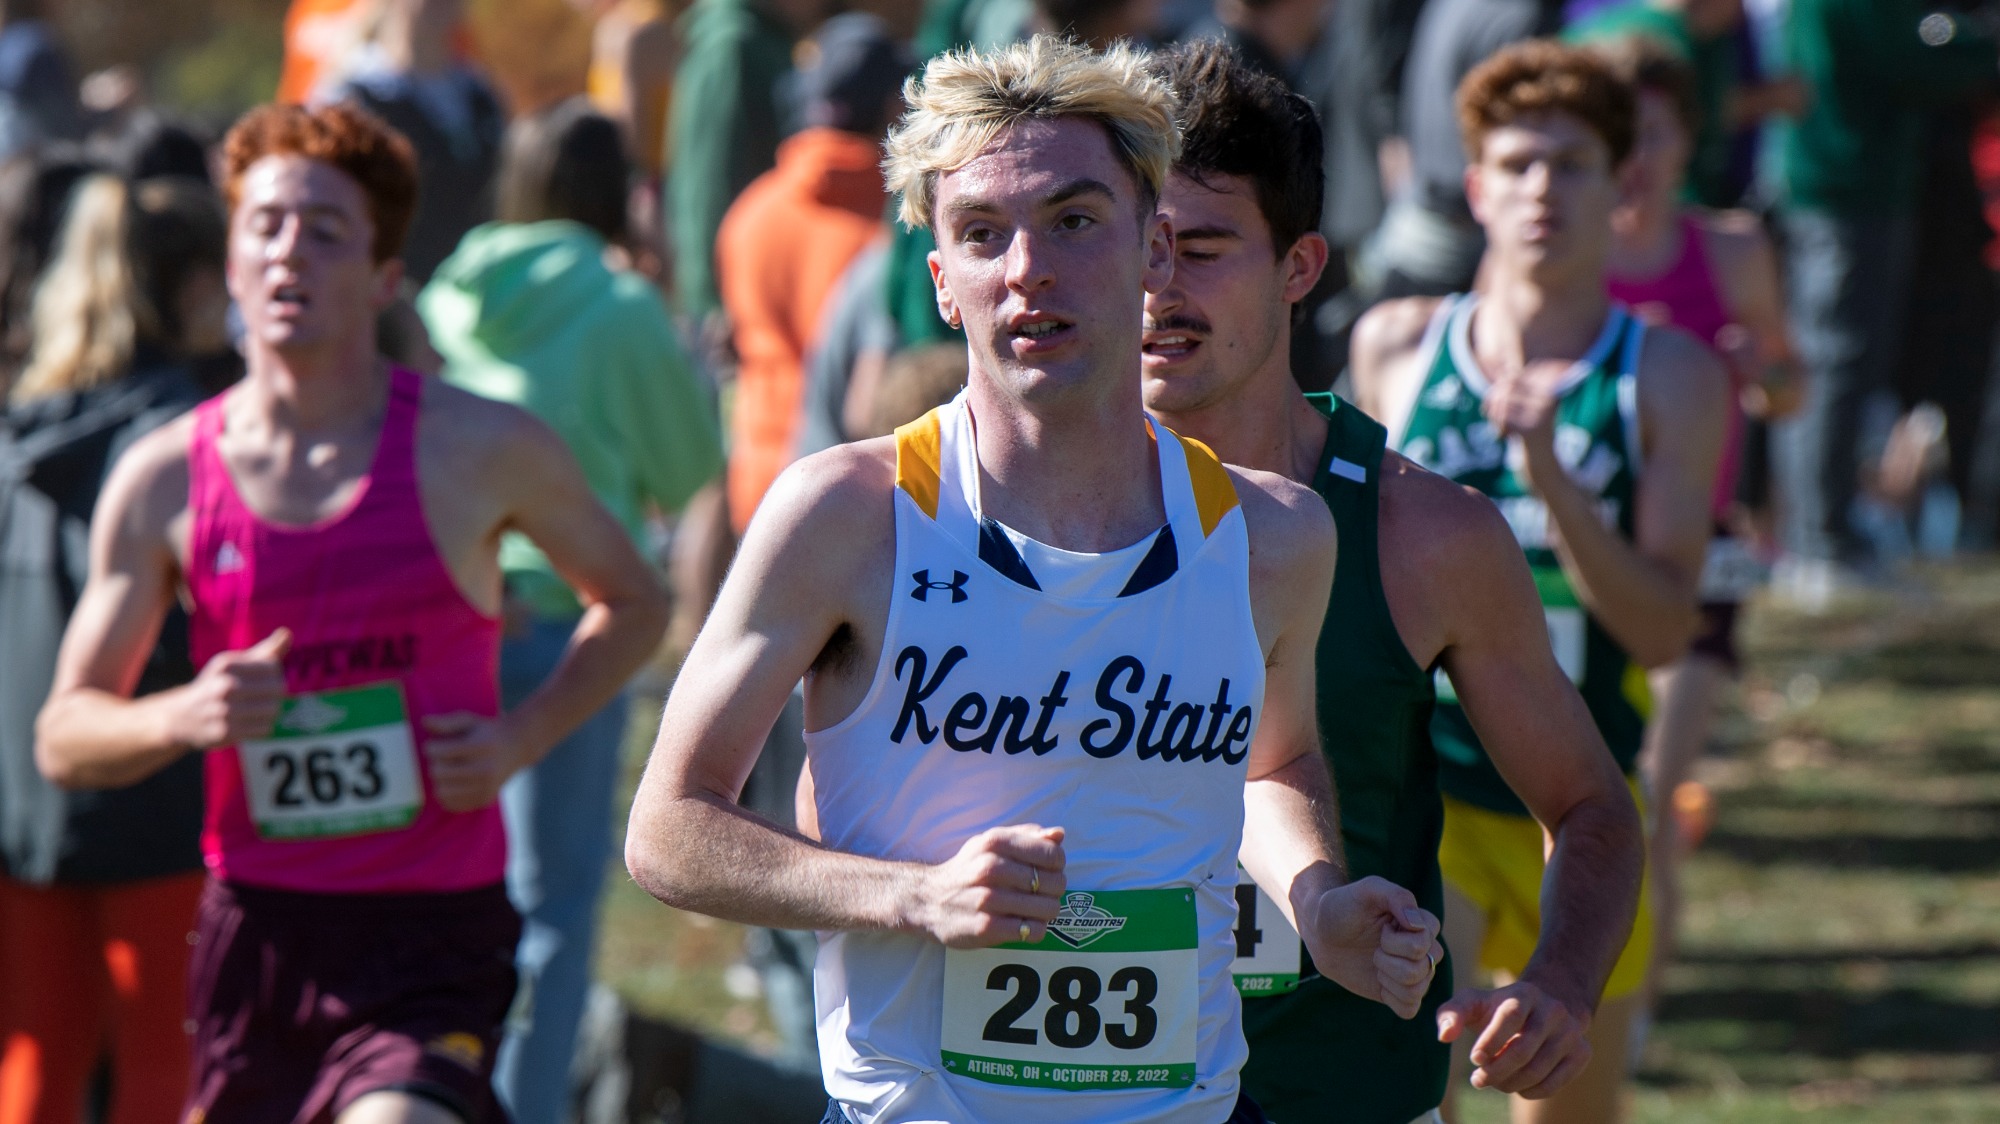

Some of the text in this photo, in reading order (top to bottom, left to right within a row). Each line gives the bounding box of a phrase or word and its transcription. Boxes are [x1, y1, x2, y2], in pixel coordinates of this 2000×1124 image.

[889, 645, 1252, 765] Kent State
[266, 742, 384, 809] 263
[1047, 918, 1124, 927] OSS COUNTRY
[981, 963, 1159, 1050] 283
[1242, 978, 1273, 991] 2022
[967, 1059, 1170, 1084] ATHENS, OH OCTOBER 29, 2022
